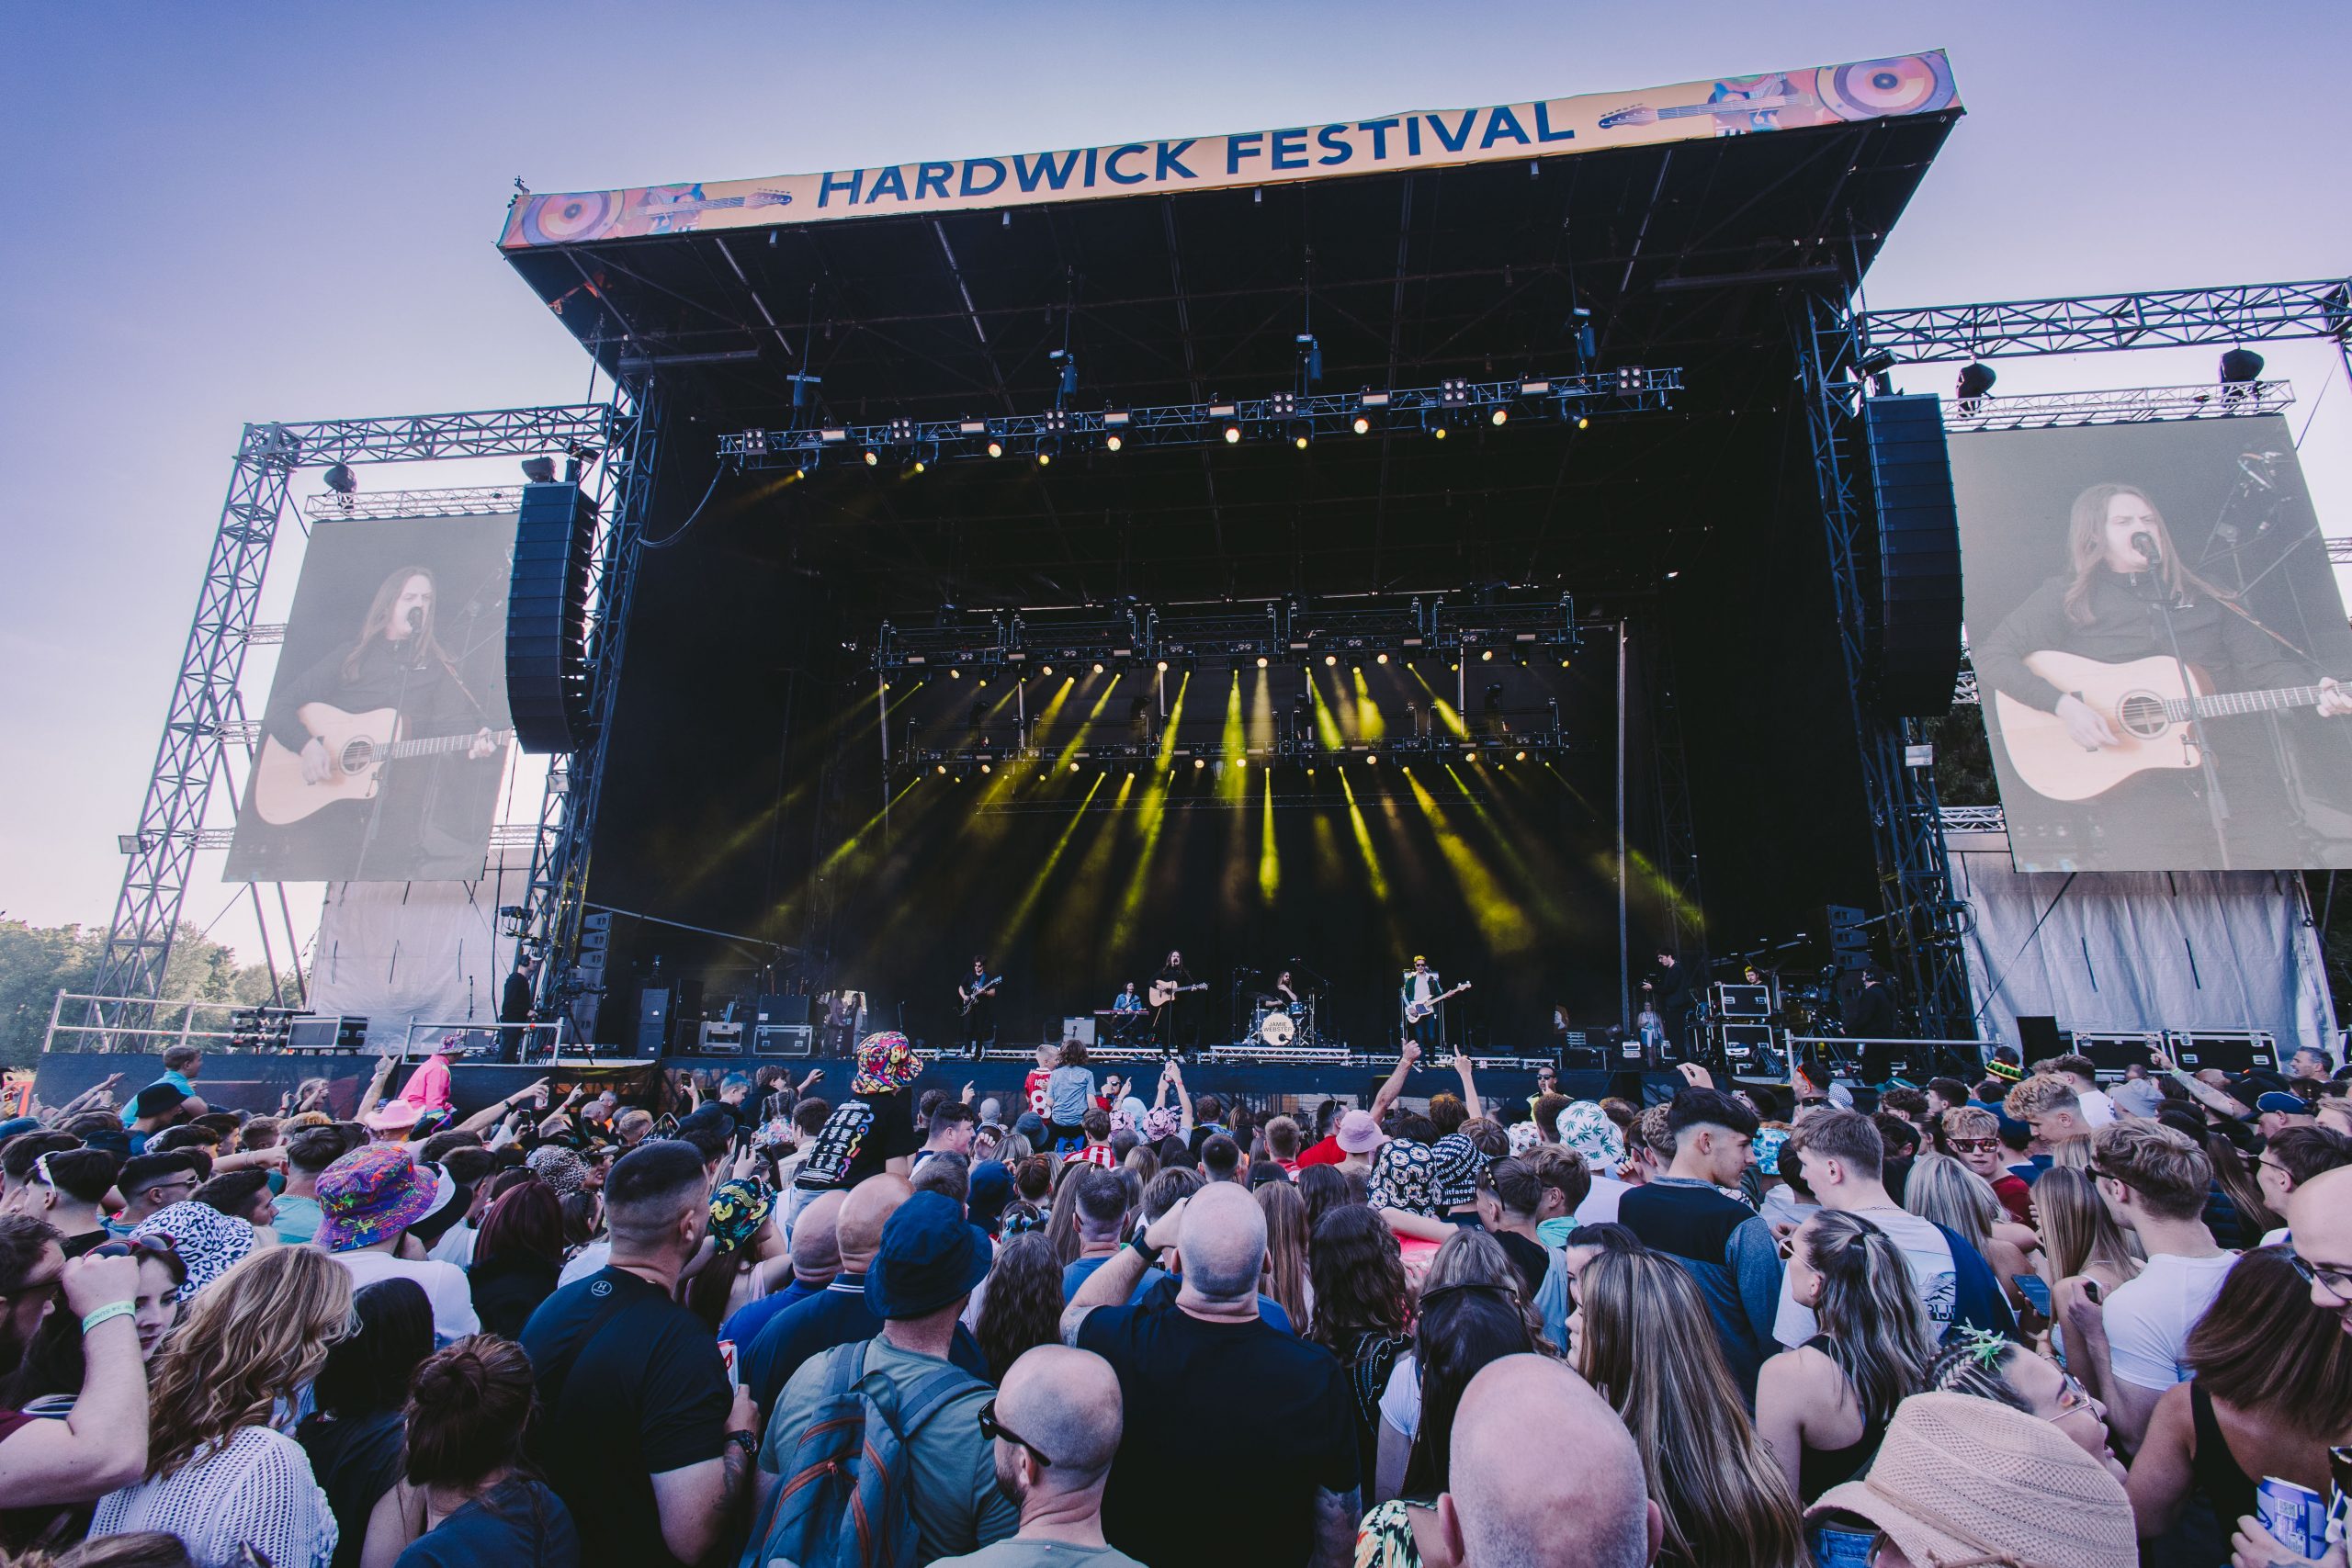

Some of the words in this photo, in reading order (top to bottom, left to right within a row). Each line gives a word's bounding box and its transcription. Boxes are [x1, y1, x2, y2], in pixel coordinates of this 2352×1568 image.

[817, 140, 1199, 209] HARDWICK
[1227, 101, 1575, 175] FESTIVAL
[1031, 1089, 1051, 1119] 8
